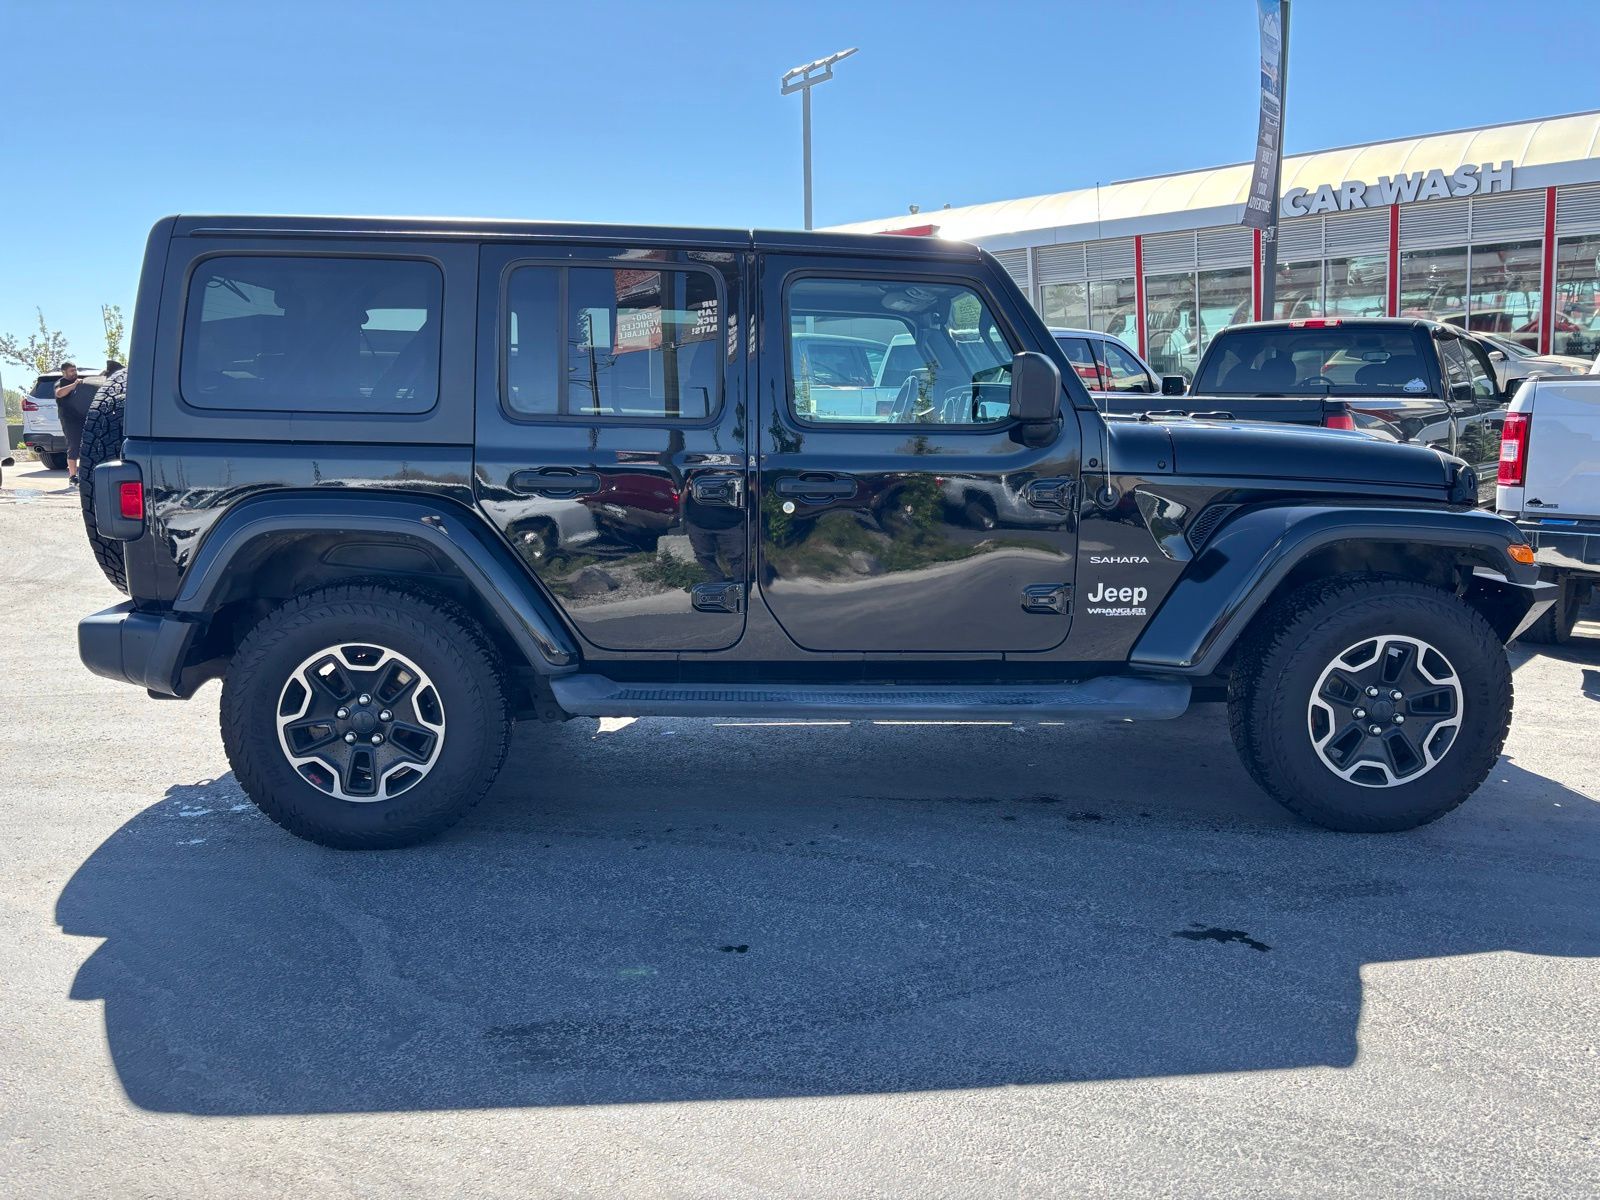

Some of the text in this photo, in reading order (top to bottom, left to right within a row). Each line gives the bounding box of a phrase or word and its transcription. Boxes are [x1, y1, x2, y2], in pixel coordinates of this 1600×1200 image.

[1282, 160, 1514, 217] CAR WASH
[1090, 556, 1149, 564] SAHARA
[1087, 582, 1148, 606] Jeep
